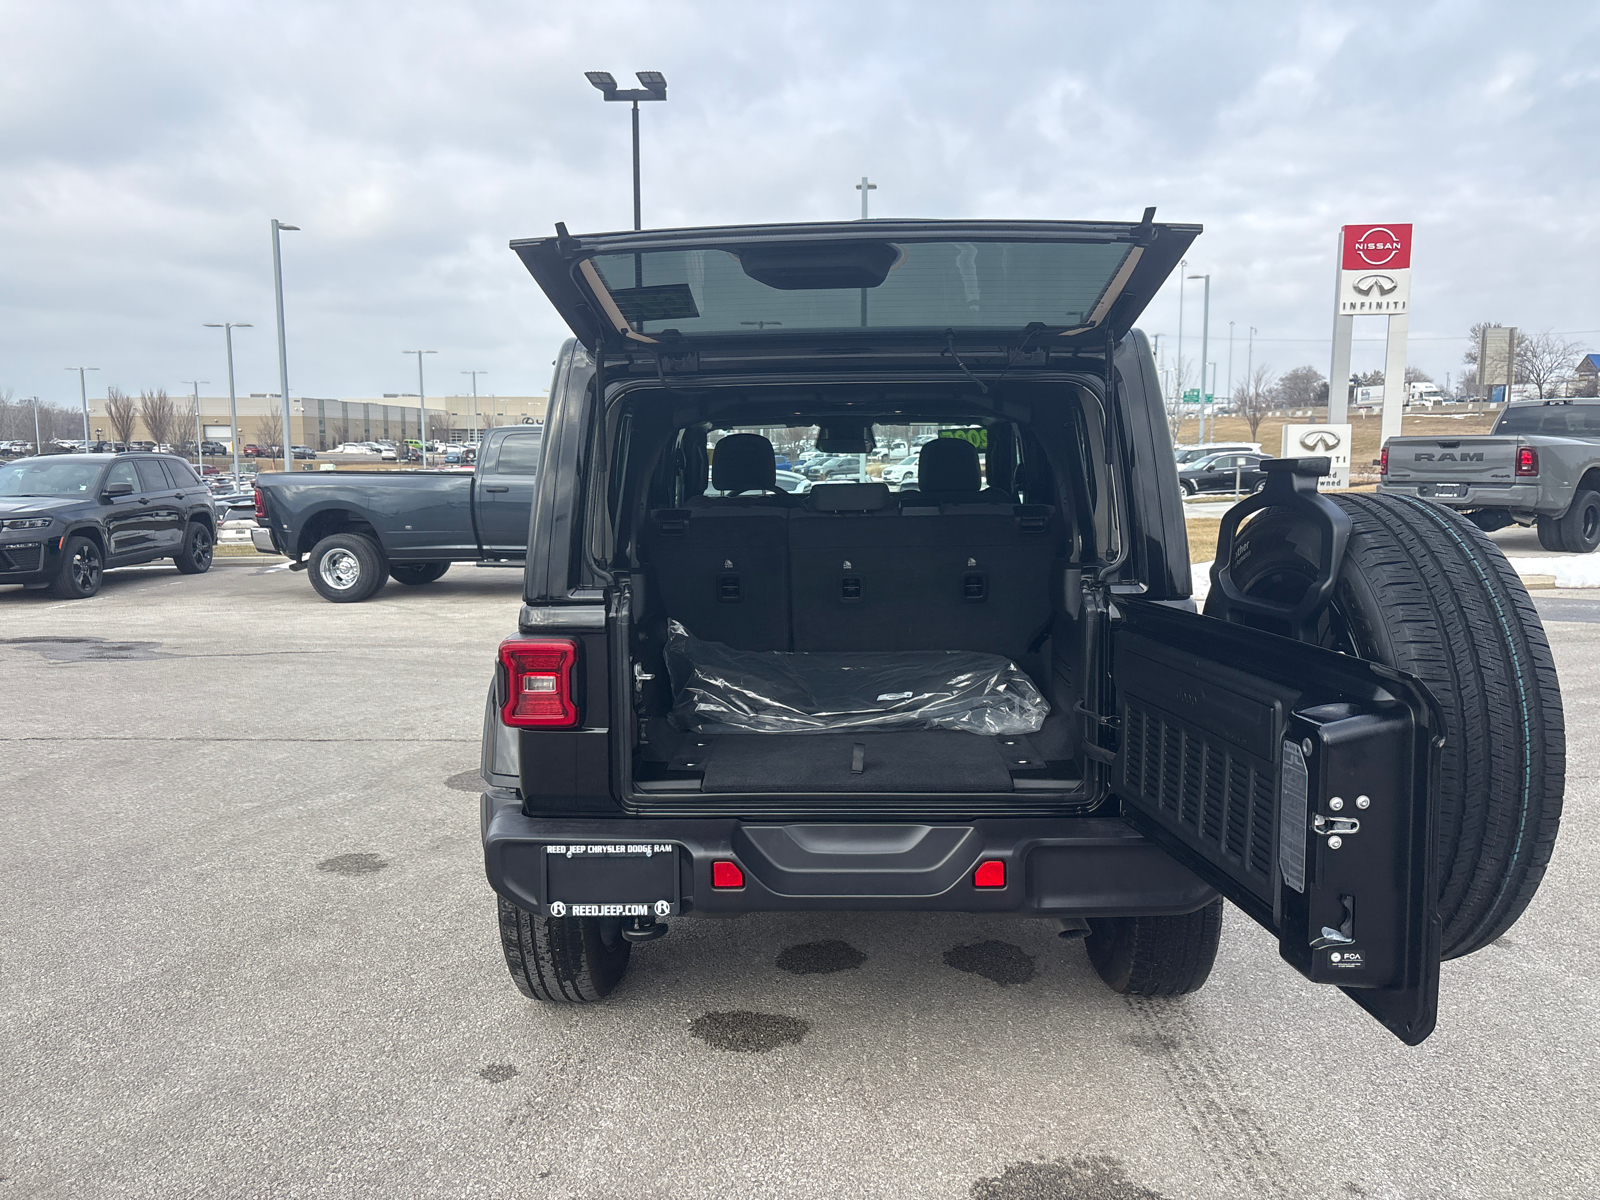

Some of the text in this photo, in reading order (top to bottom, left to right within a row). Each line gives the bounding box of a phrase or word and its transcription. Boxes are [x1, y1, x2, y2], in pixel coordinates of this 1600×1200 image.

[1355, 242, 1401, 250] NISSAN
[1342, 301, 1406, 310] INFINITI
[1414, 452, 1485, 462] RAM
[546, 844, 672, 854] REED JEEP CHRYSLER DODGE RAM
[572, 904, 648, 916] REEDJEEP.COM
